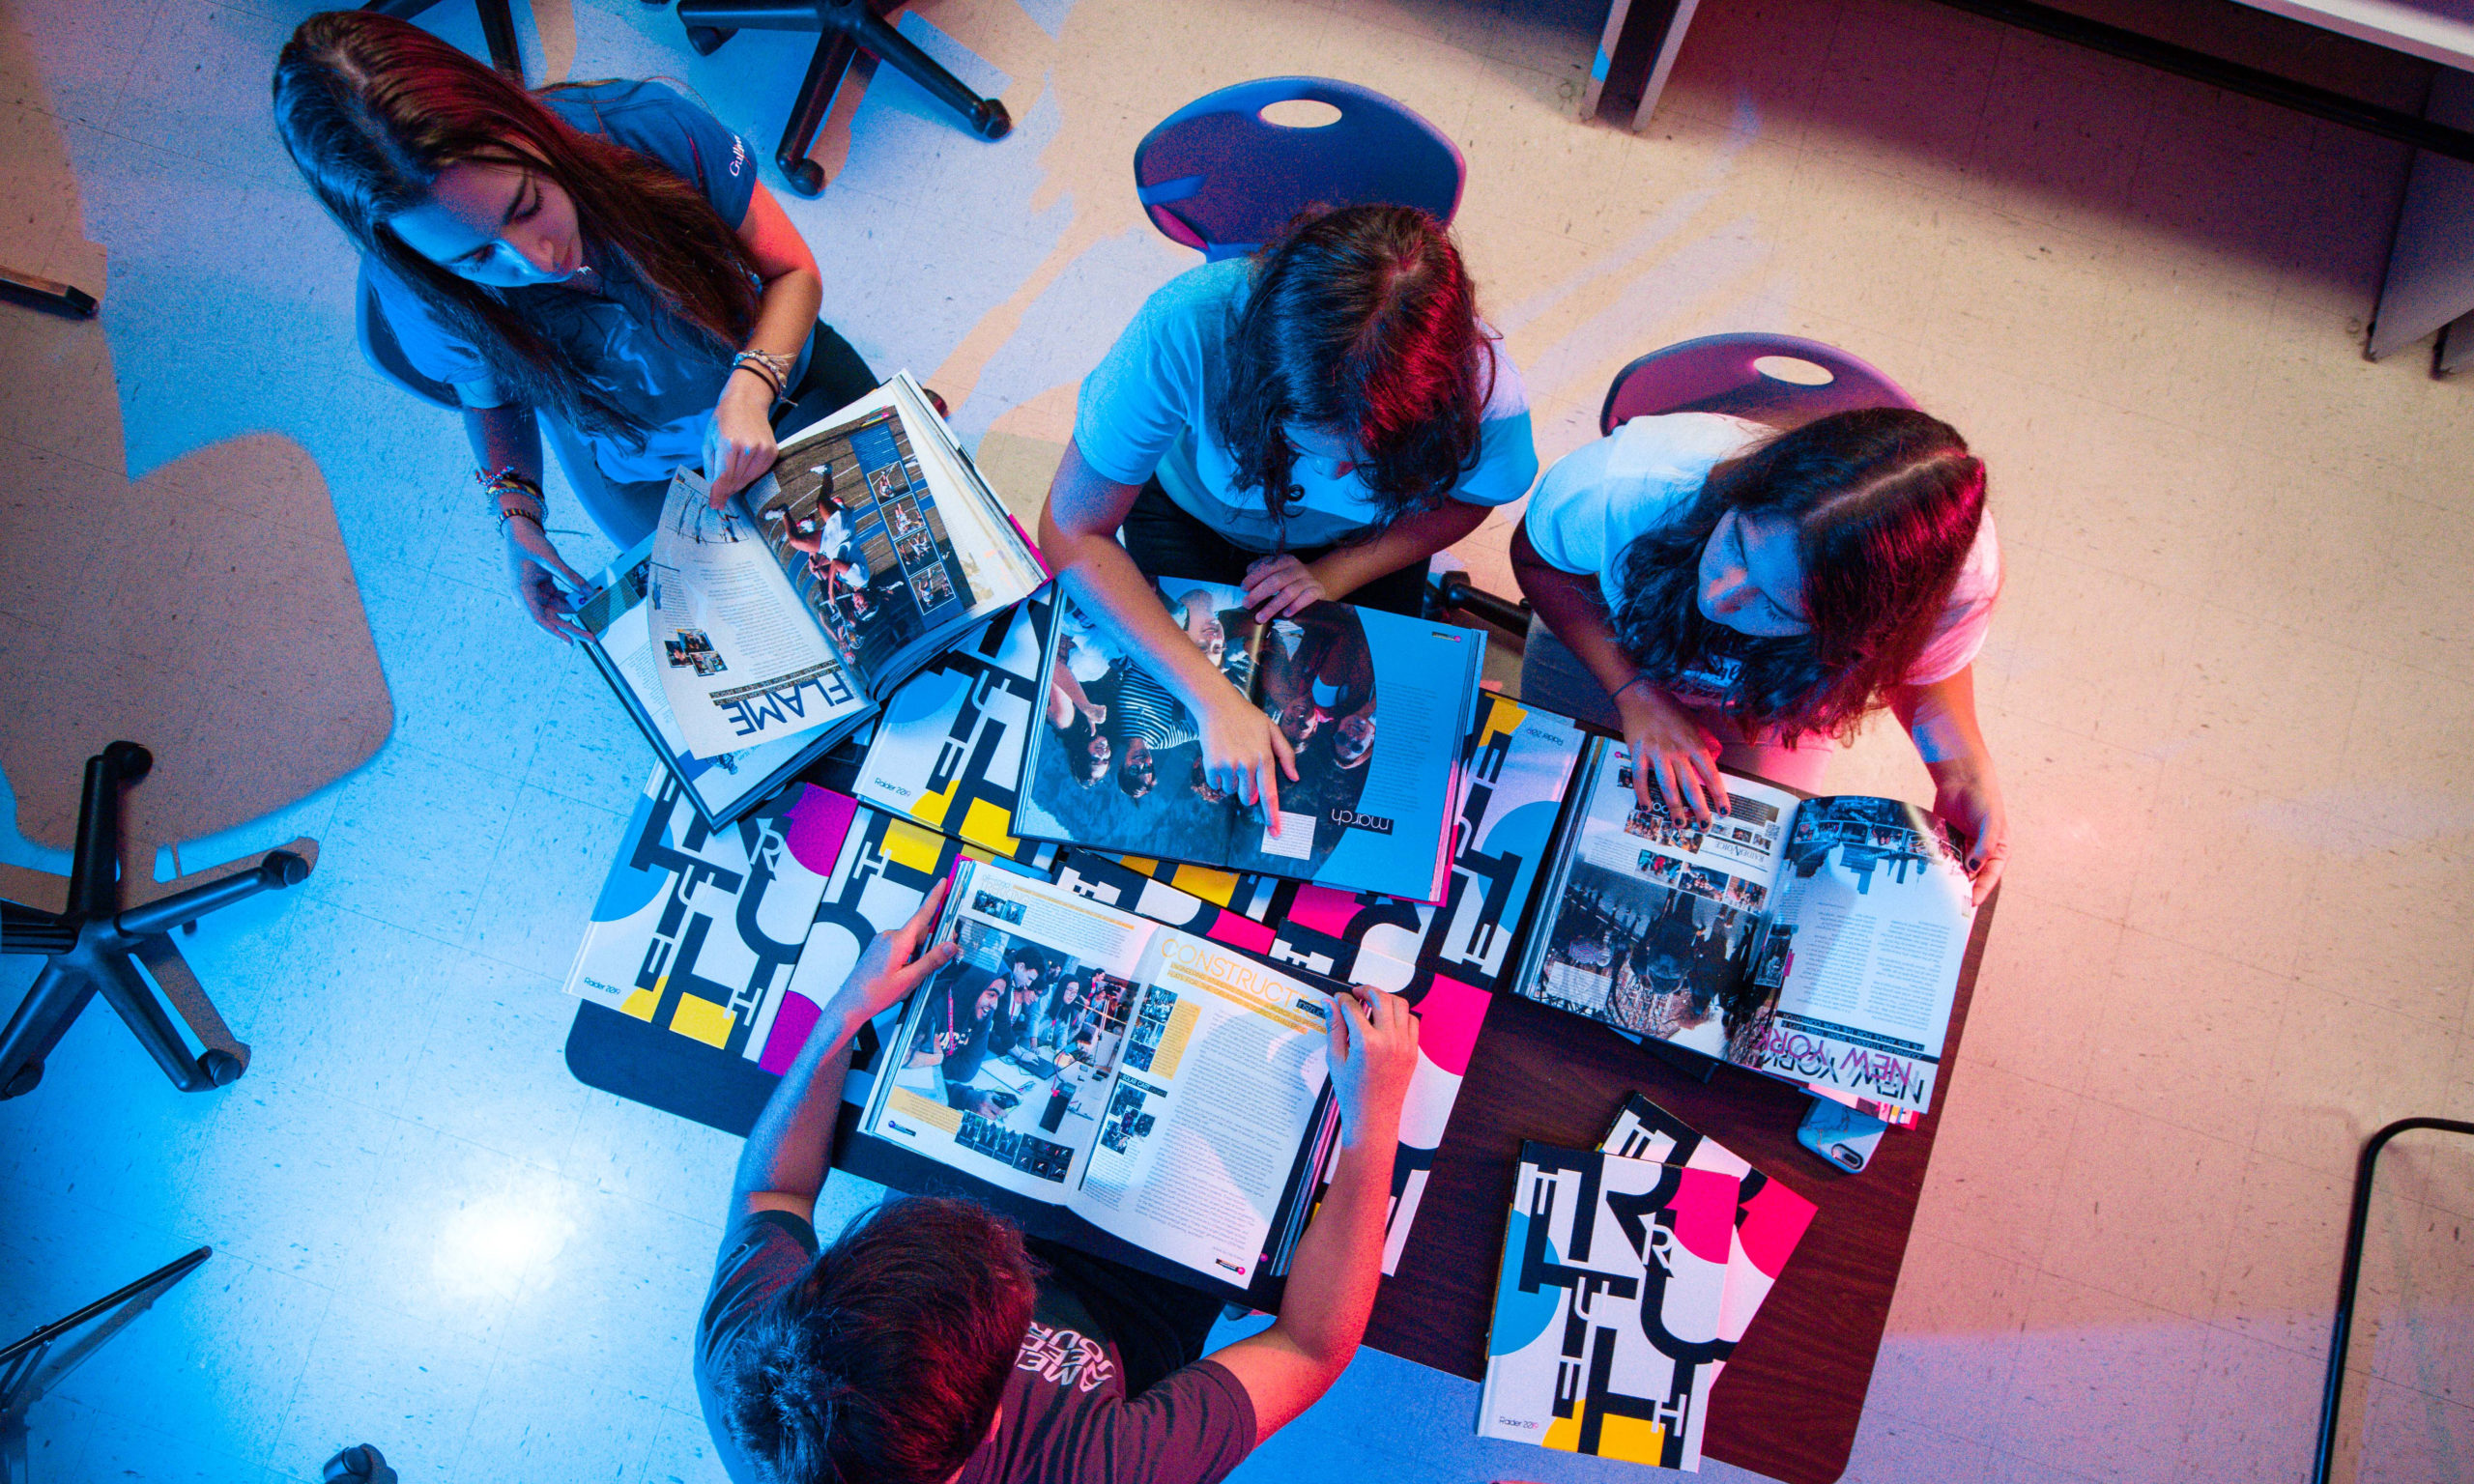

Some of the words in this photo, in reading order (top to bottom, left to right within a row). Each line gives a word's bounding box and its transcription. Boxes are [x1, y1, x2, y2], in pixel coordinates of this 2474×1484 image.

[721, 670, 853, 736] FLAME
[874, 777, 896, 791] Raider
[1331, 808, 1390, 830] march
[584, 977, 606, 989] Raider
[1162, 938, 1326, 1023] CONSTRUCTIO
[1782, 1013, 1821, 1026] CONVENTION
[1805, 1026, 1824, 1036] THREE
[1827, 1031, 1847, 1041] SPENT
[1755, 1024, 1826, 1062] YORK
[1849, 1037, 1880, 1048] STUDENTS
[1873, 1034, 1895, 1043] APPLE
[1897, 1039, 1910, 1047] BIG
[1882, 1044, 1922, 1059] JOURNALISM
[1840, 1047, 1912, 1085] NEW
[1850, 1066, 1924, 1103] NEW
[1499, 1415, 1522, 1427] Raider
